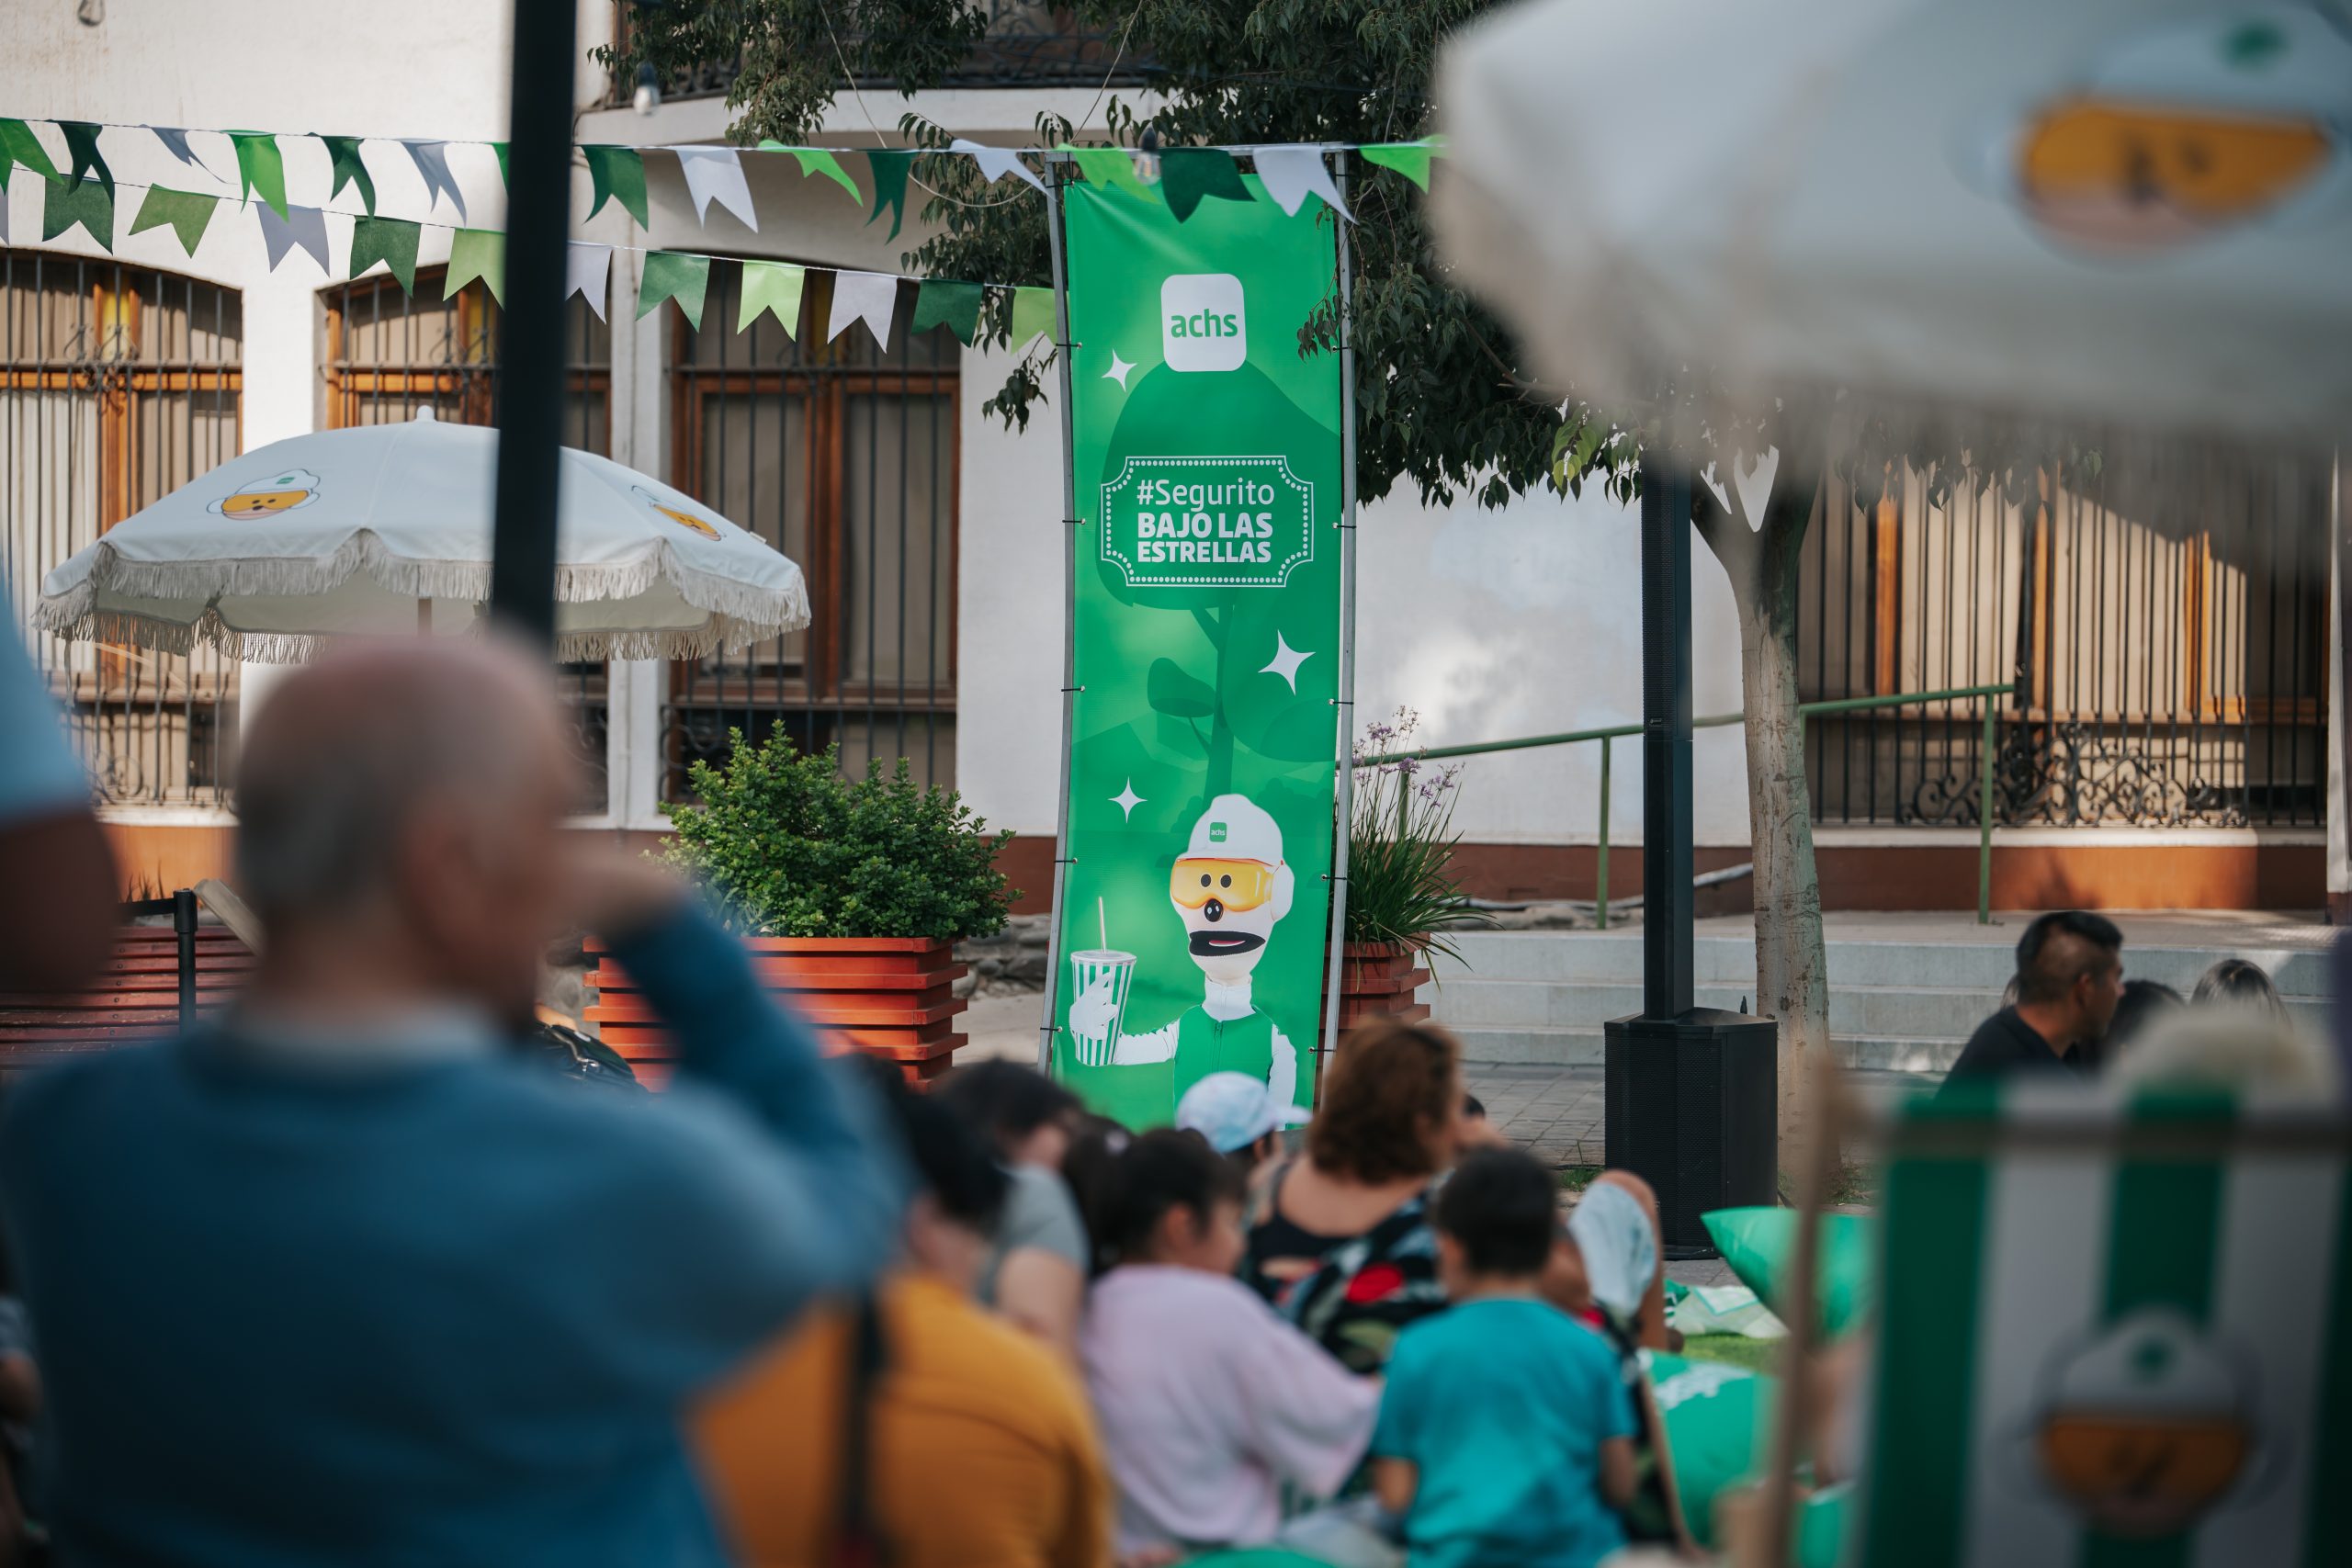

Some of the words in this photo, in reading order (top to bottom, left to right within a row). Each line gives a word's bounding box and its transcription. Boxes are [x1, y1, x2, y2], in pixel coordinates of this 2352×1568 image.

[1170, 308, 1238, 338] achs
[1136, 477, 1275, 513] #Segurito
[1137, 512, 1213, 538] BAJO
[1218, 512, 1273, 538] LAS
[1137, 540, 1272, 563] ESTRELLAS
